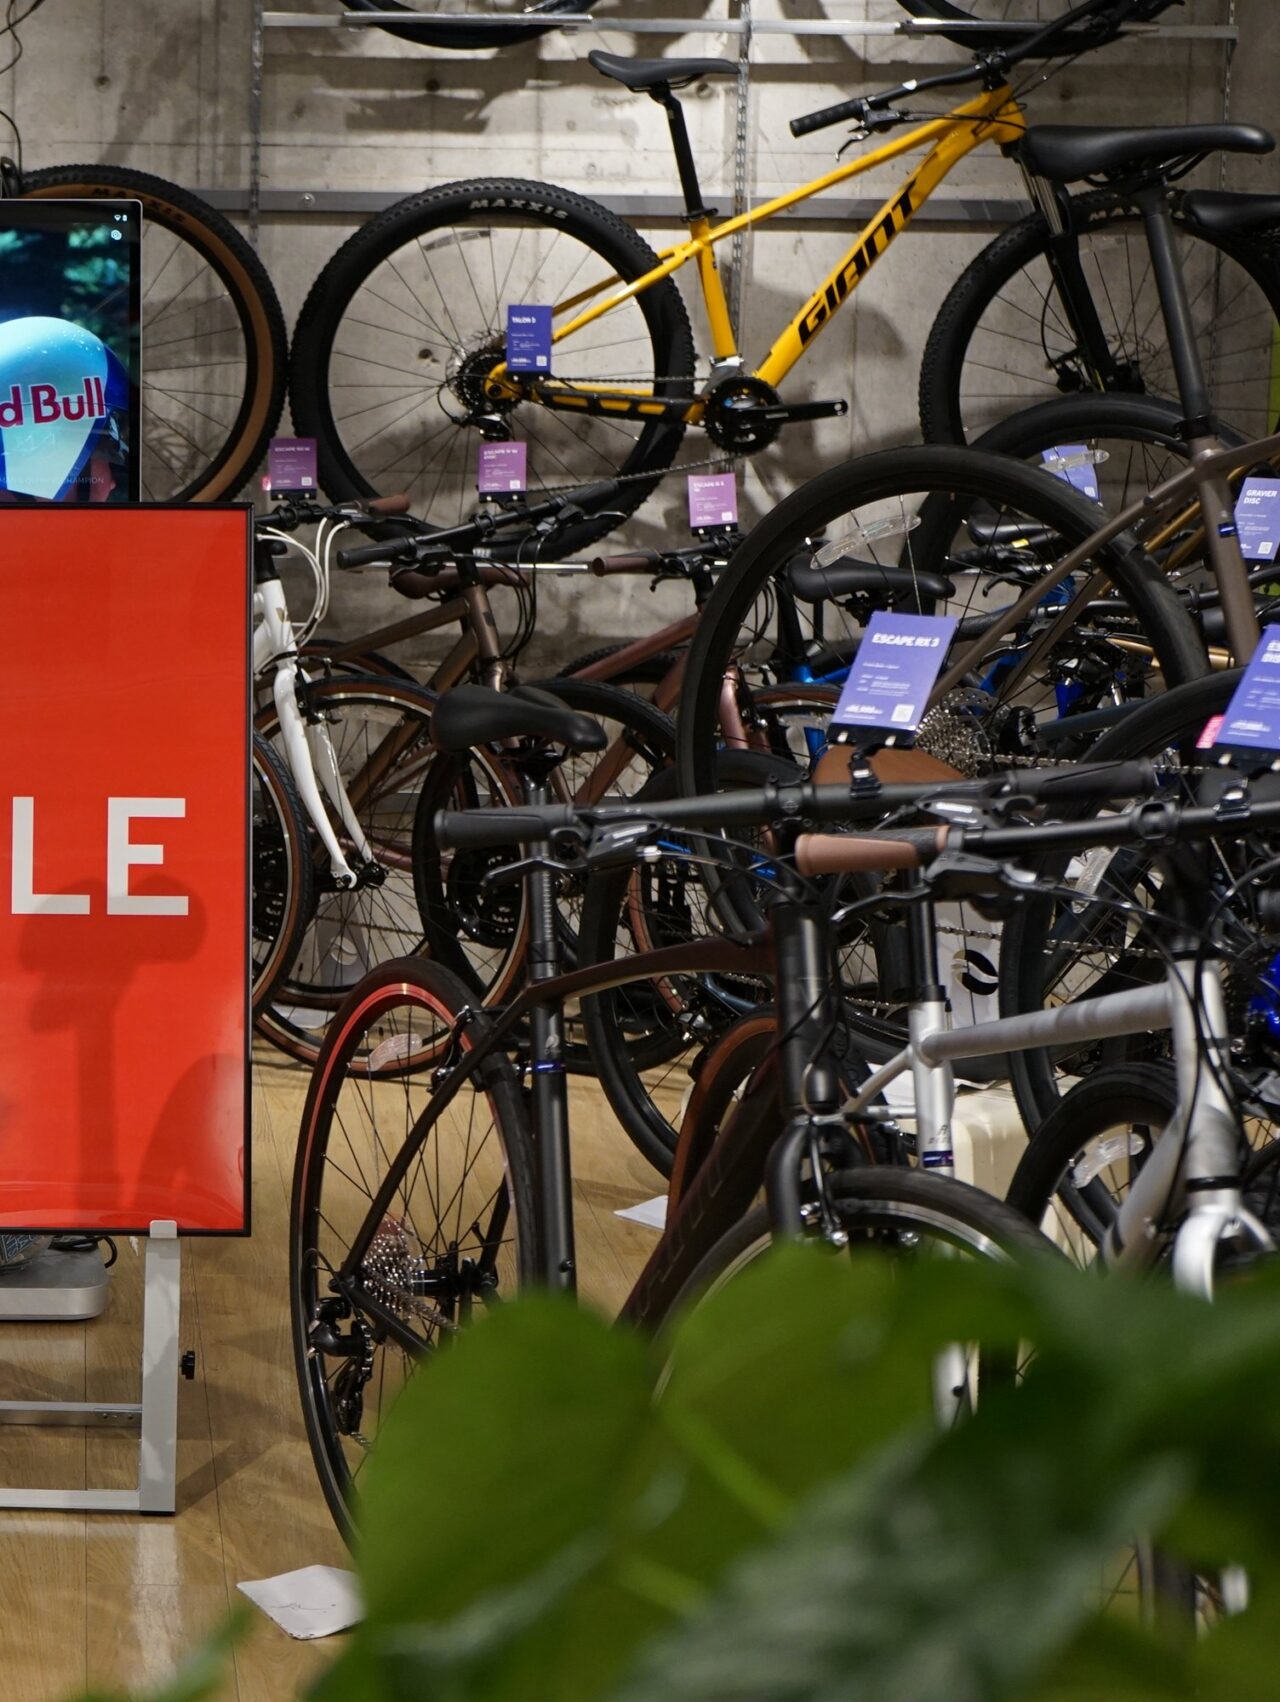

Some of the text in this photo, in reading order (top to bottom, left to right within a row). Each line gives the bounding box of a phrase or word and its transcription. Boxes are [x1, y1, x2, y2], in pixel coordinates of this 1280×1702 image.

[469, 198, 569, 219] MAXXIS
[798, 178, 918, 346] GIANT
[29, 376, 106, 425] Bull
[871, 632, 914, 646] ESCAPE
